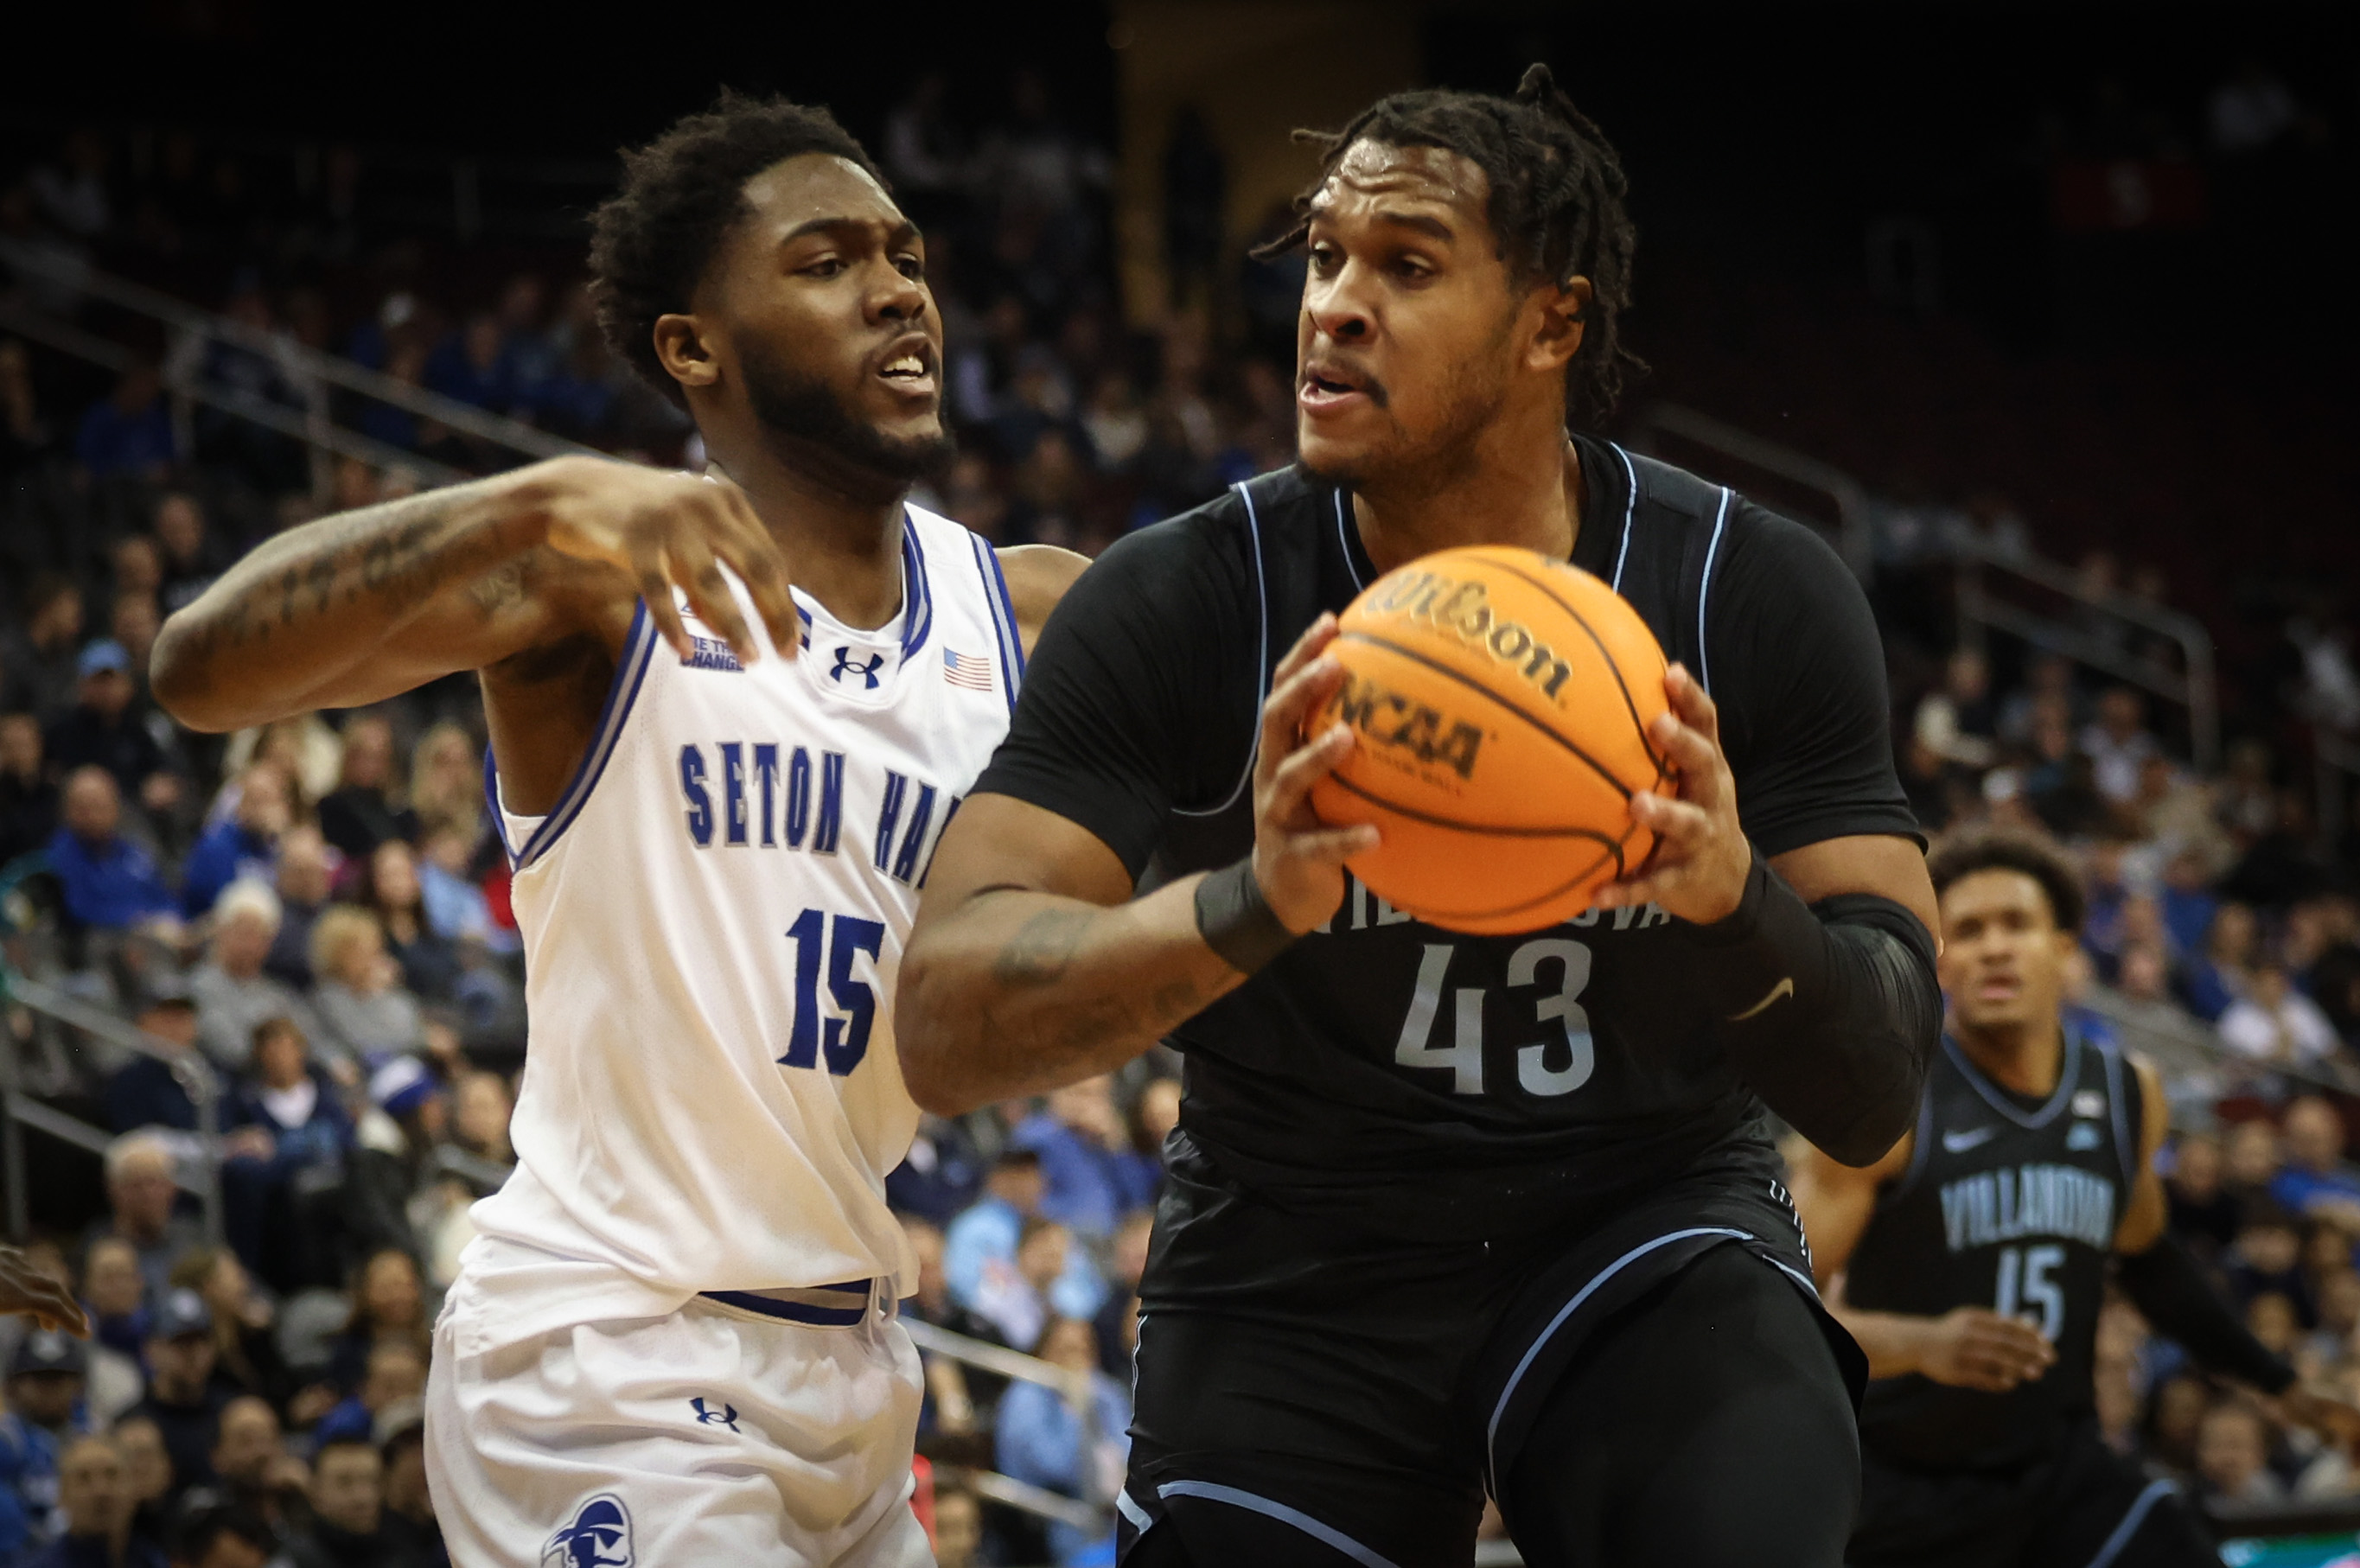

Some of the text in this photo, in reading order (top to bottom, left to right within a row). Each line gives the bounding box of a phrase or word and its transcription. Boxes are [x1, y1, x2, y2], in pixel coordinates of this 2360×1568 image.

[1361, 571, 1572, 698] Wilson
[677, 741, 846, 857] SETON
[775, 908, 885, 1076] 15
[1395, 939, 1595, 1096] 43
[1996, 1246, 2065, 1342] 15
